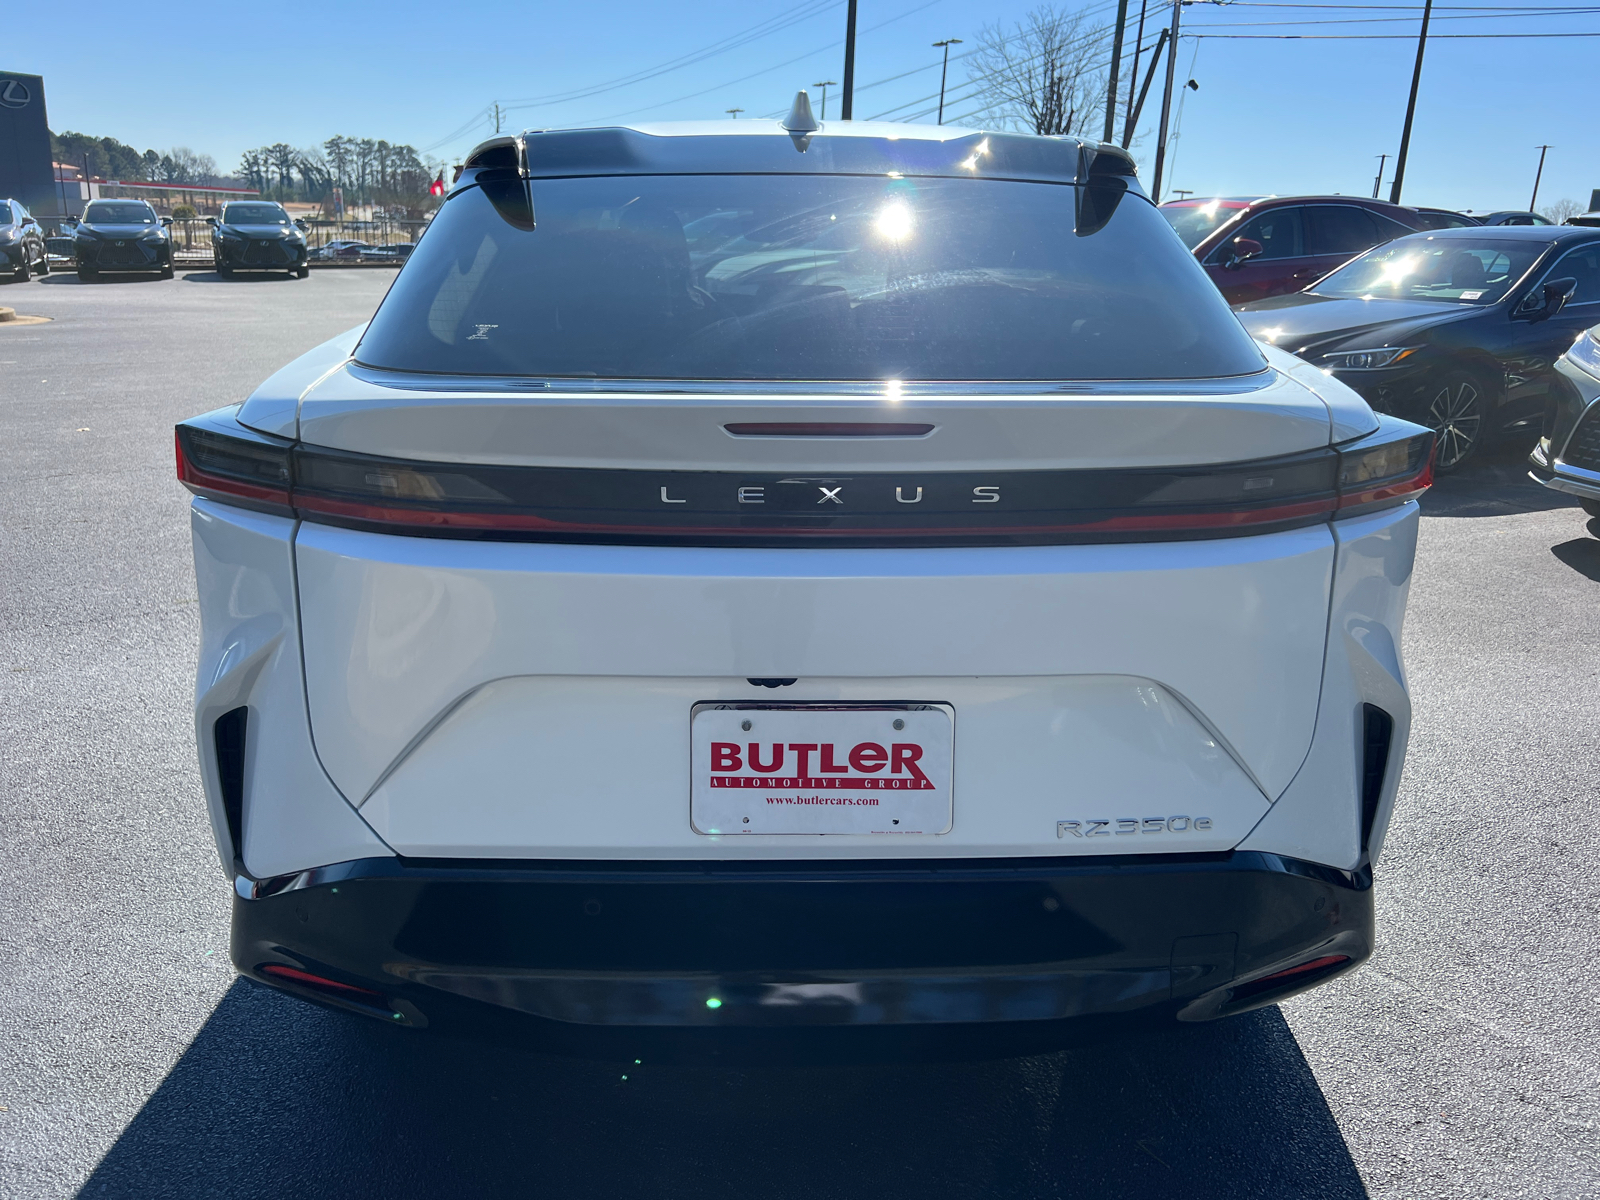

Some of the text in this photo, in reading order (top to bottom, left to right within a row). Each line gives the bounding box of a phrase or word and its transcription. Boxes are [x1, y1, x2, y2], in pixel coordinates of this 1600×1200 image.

[660, 486, 1001, 504] LEXUS
[711, 777, 928, 789] AUTOMOTIVE GROUP
[765, 795, 880, 806] www.butlercars.com
